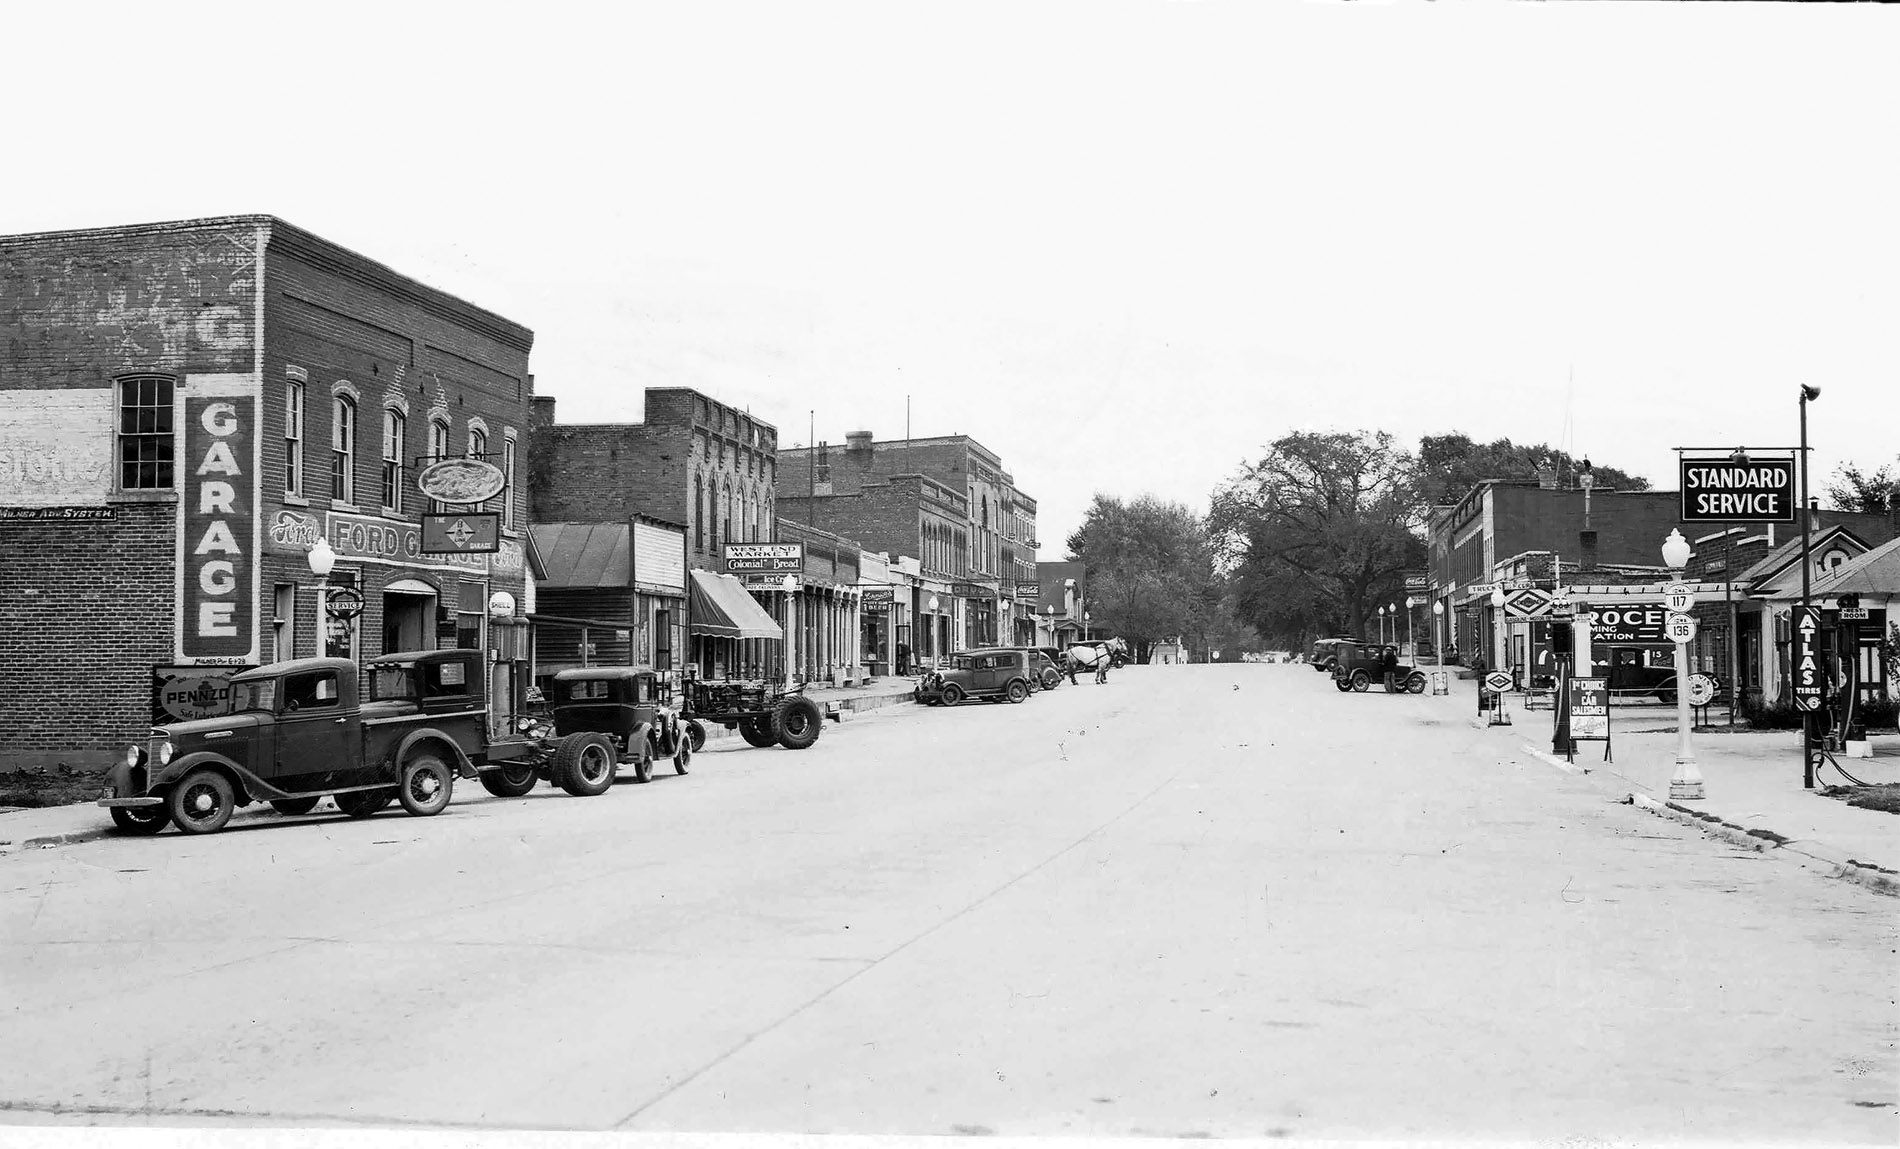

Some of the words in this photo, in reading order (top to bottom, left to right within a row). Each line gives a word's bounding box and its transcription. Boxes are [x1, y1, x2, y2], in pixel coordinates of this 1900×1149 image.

[1687, 468, 1787, 488] STANDARD
[1697, 493, 1778, 513] SERVICE
[195, 403, 242, 637] GARAGE
[270, 510, 318, 546] Ford
[335, 520, 399, 556] FORD
[773, 558, 799, 570] Bread
[764, 575, 775, 583] Ice
[327, 602, 363, 610] SERVICE
[1672, 595, 1687, 607] 117
[1673, 625, 1689, 637] 136
[1799, 614, 1817, 686] ATLAS
[1581, 680, 1606, 691] CHOICE
[1795, 687, 1821, 695] TIRES
[166, 688, 234, 705] PENNZO
[180, 708, 194, 719] Safe
[1571, 705, 1607, 716] SALESMEN
